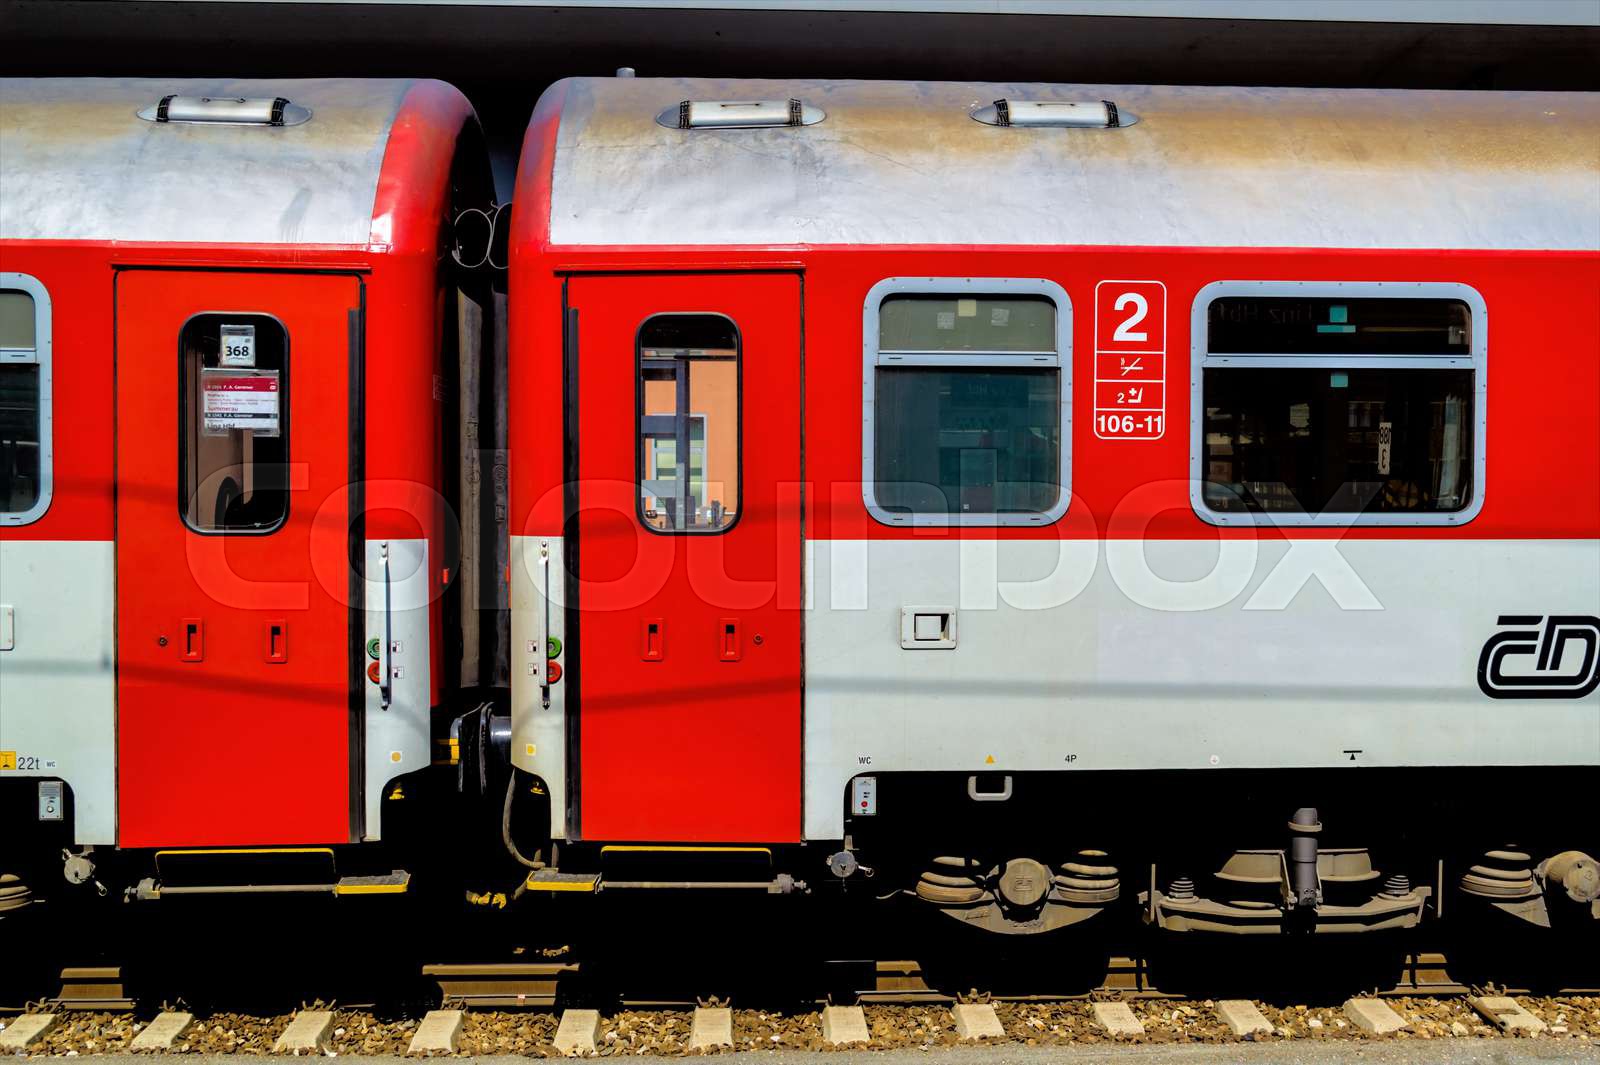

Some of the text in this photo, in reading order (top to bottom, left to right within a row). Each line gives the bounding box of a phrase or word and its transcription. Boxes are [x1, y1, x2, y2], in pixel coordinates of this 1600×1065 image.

[1112, 292, 1148, 342] 2
[225, 345, 249, 357] 368
[1116, 392, 1125, 404] 2
[1097, 414, 1162, 433] 106-11
[18, 757, 40, 770] 22t
[858, 756, 871, 765] WC
[1064, 754, 1077, 763] 4P
